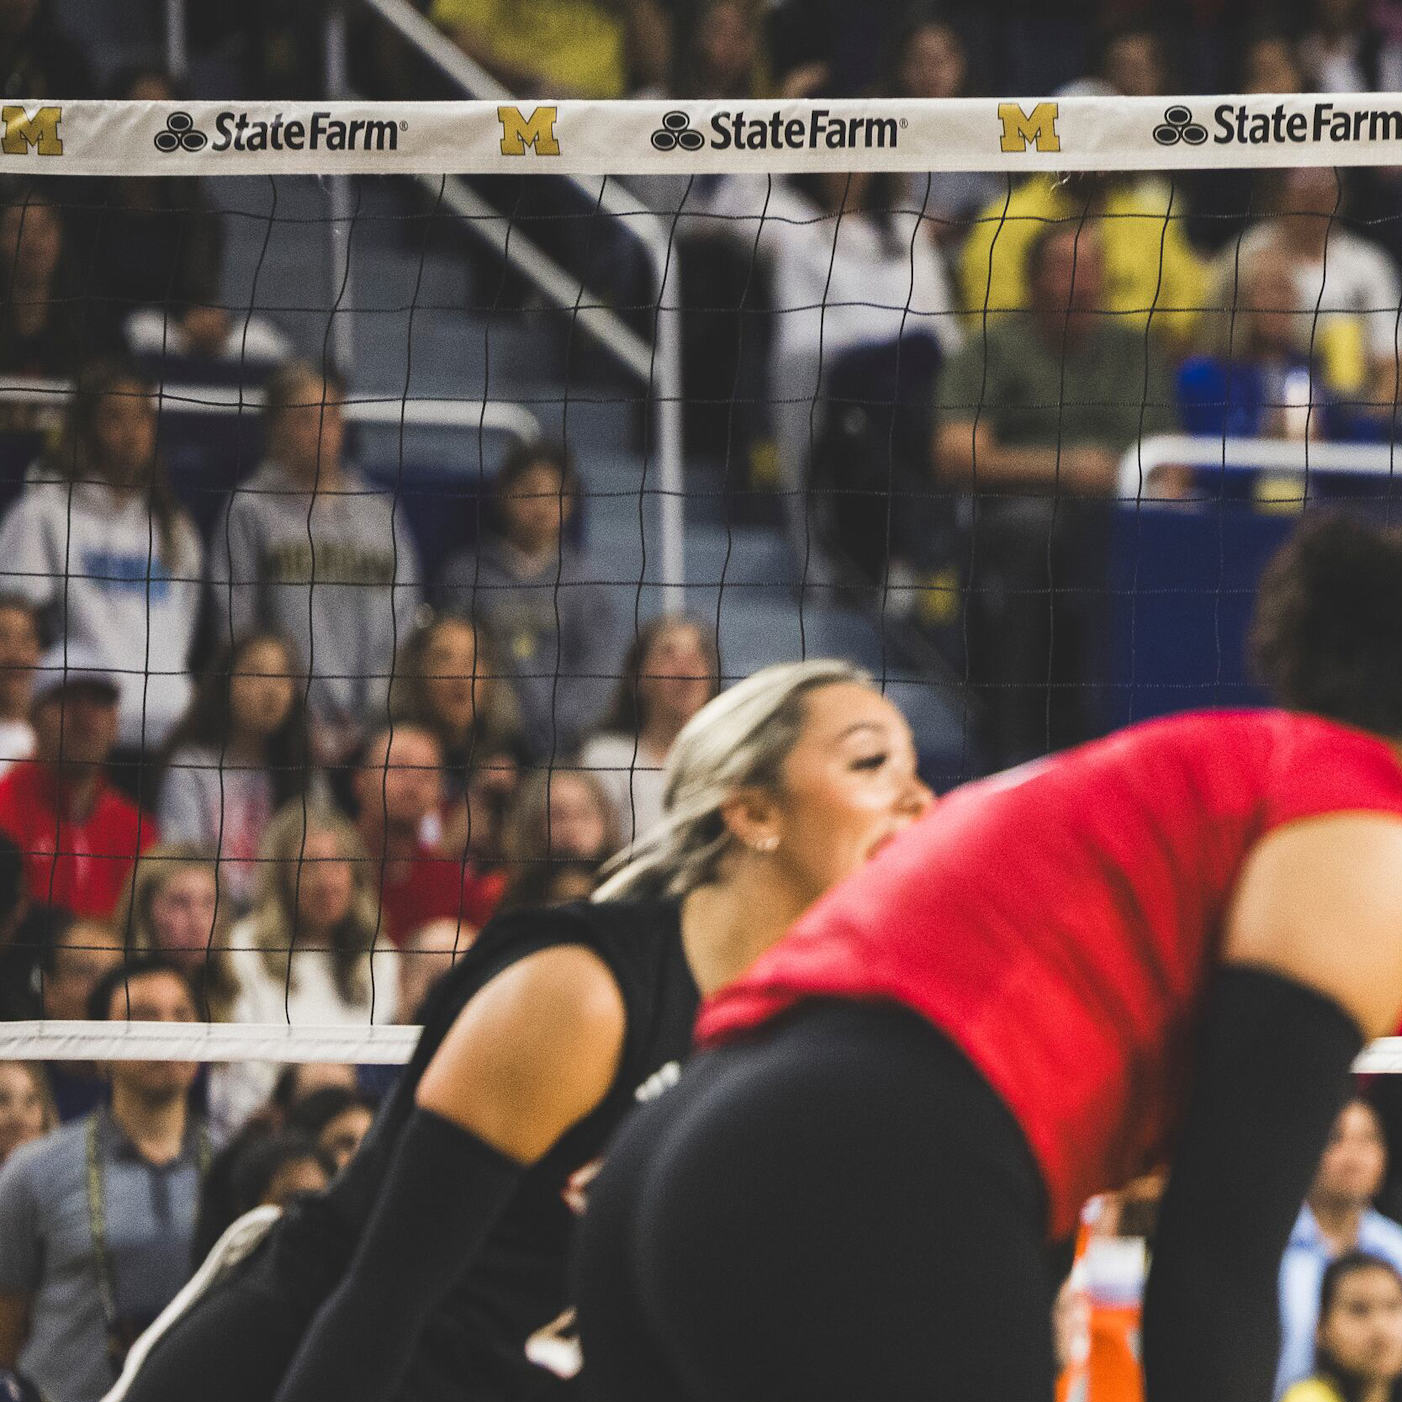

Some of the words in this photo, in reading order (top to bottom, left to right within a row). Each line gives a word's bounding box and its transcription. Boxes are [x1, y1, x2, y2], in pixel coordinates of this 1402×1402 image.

[1, 105, 63, 155] M
[497, 106, 560, 156] M
[997, 102, 1060, 152] M
